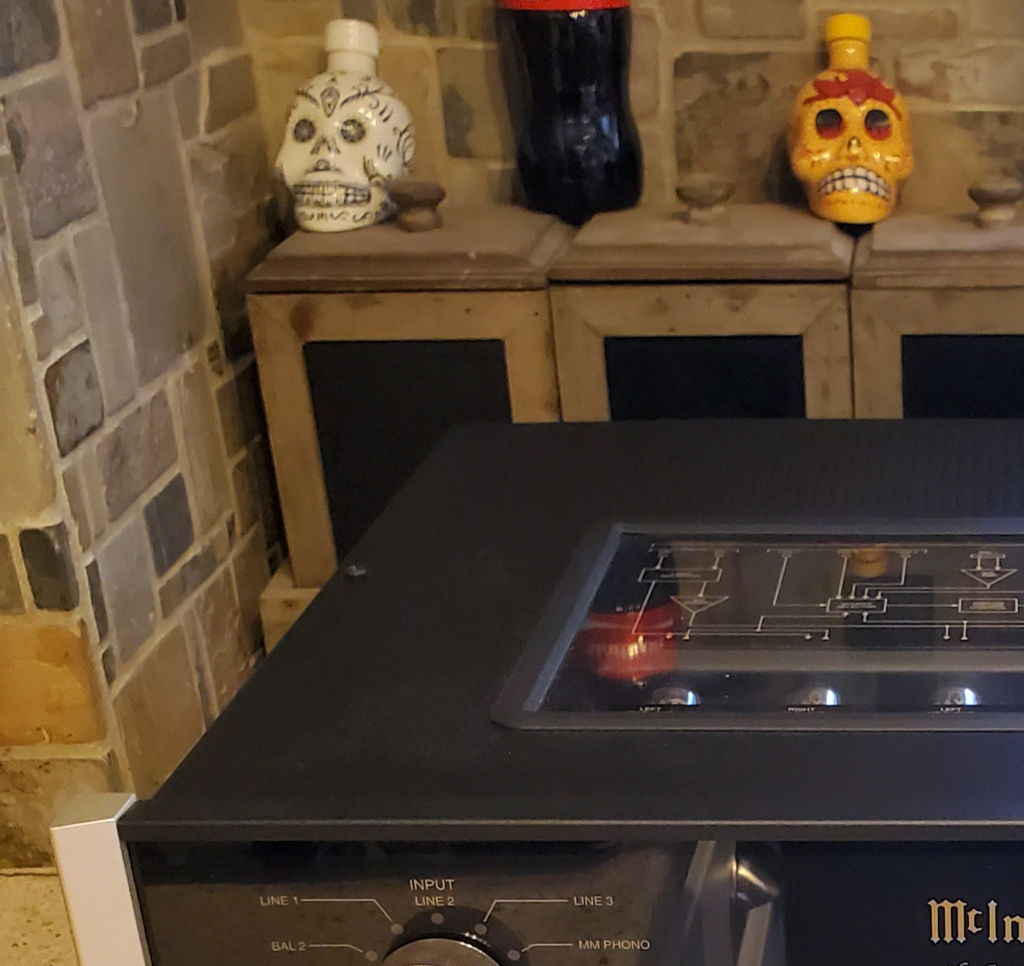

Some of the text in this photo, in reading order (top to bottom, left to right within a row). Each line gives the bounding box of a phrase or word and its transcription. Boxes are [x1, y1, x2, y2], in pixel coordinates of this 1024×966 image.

[410, 879, 455, 891] INPUT
[260, 896, 298, 906] LINE 1
[415, 896, 456, 907] LINE 2
[574, 896, 614, 906] LINE 3
[271, 941, 306, 951] BAL 2
[578, 940, 651, 950] MM PHONO
